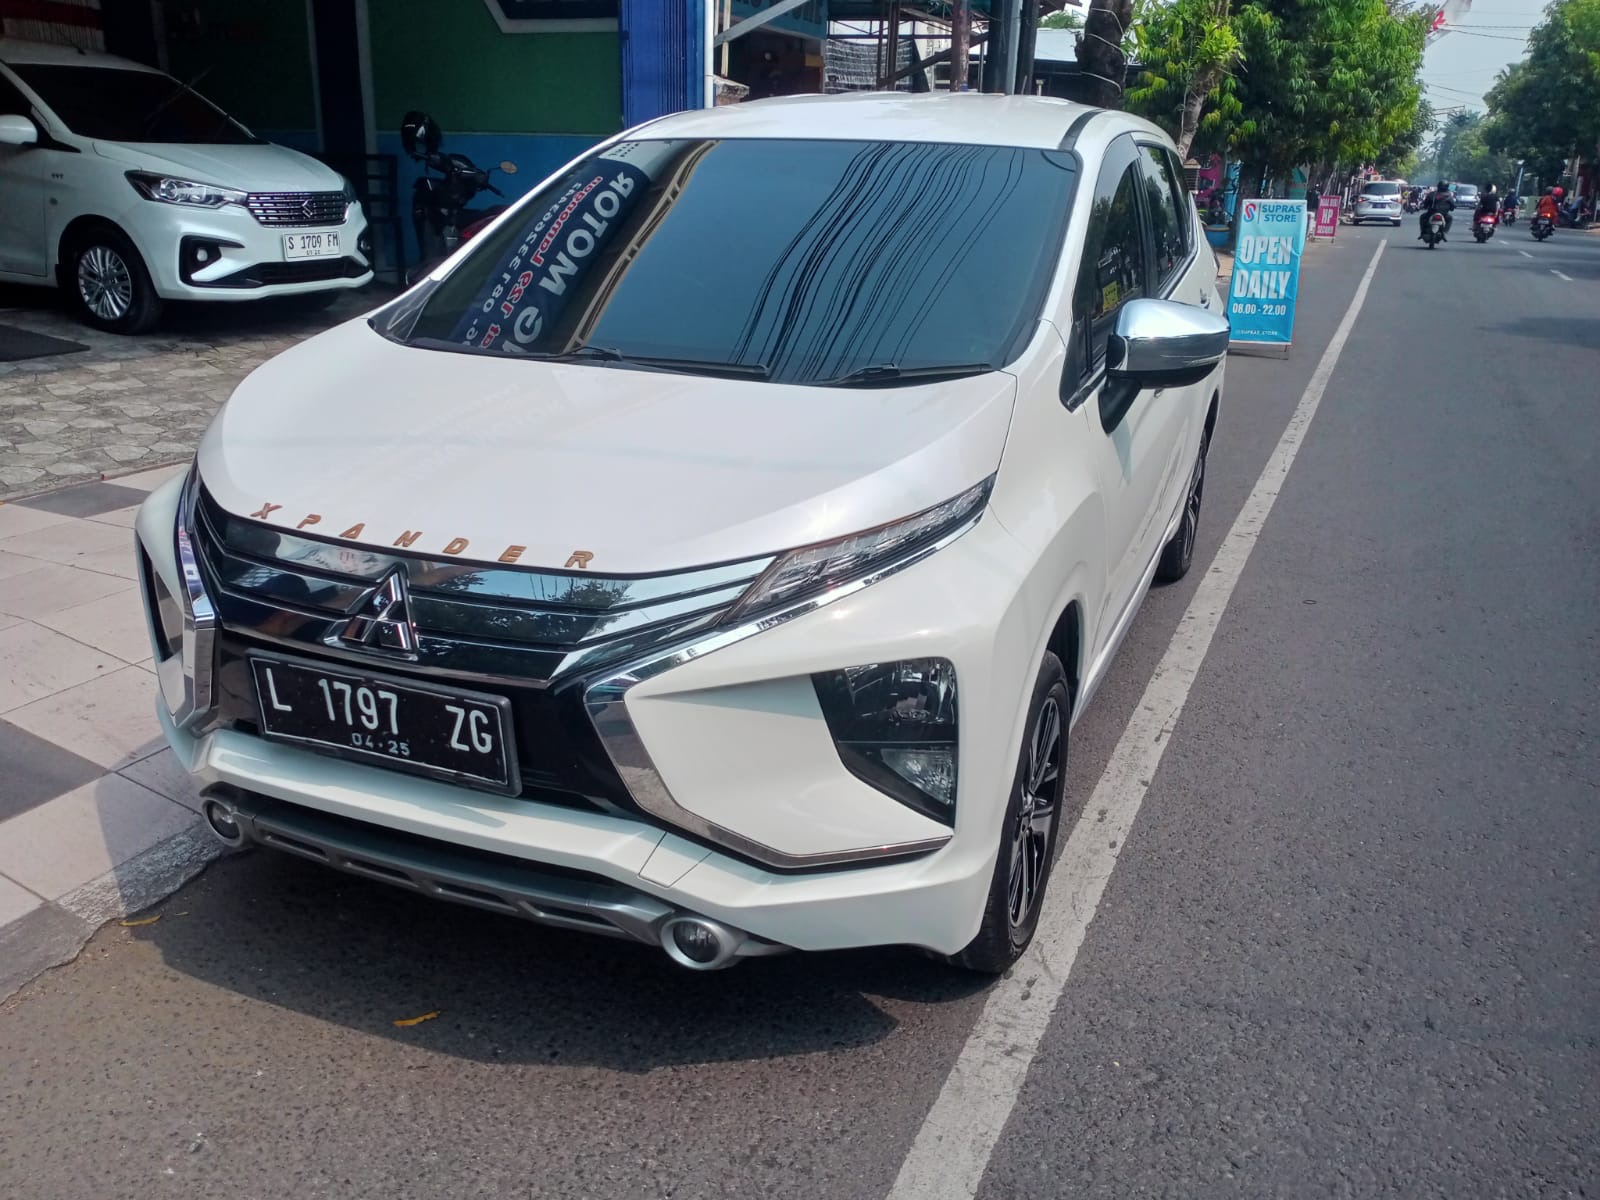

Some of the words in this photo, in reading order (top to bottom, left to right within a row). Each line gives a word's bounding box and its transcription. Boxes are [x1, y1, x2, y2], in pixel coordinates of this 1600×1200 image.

[1262, 204, 1302, 214] SUPRAS
[1322, 208, 1334, 224] HP
[1264, 214, 1297, 223] STORE
[288, 236, 295, 250] S
[301, 235, 322, 249] 1709
[1240, 235, 1293, 265] OPEN
[1233, 269, 1291, 300] DAILY
[1232, 302, 1257, 315] 08.00
[1262, 304, 1287, 316] 22.00
[250, 502, 595, 569] XPANDER
[266, 668, 292, 712] L
[317, 678, 399, 736] 1797
[445, 704, 493, 754] ZG
